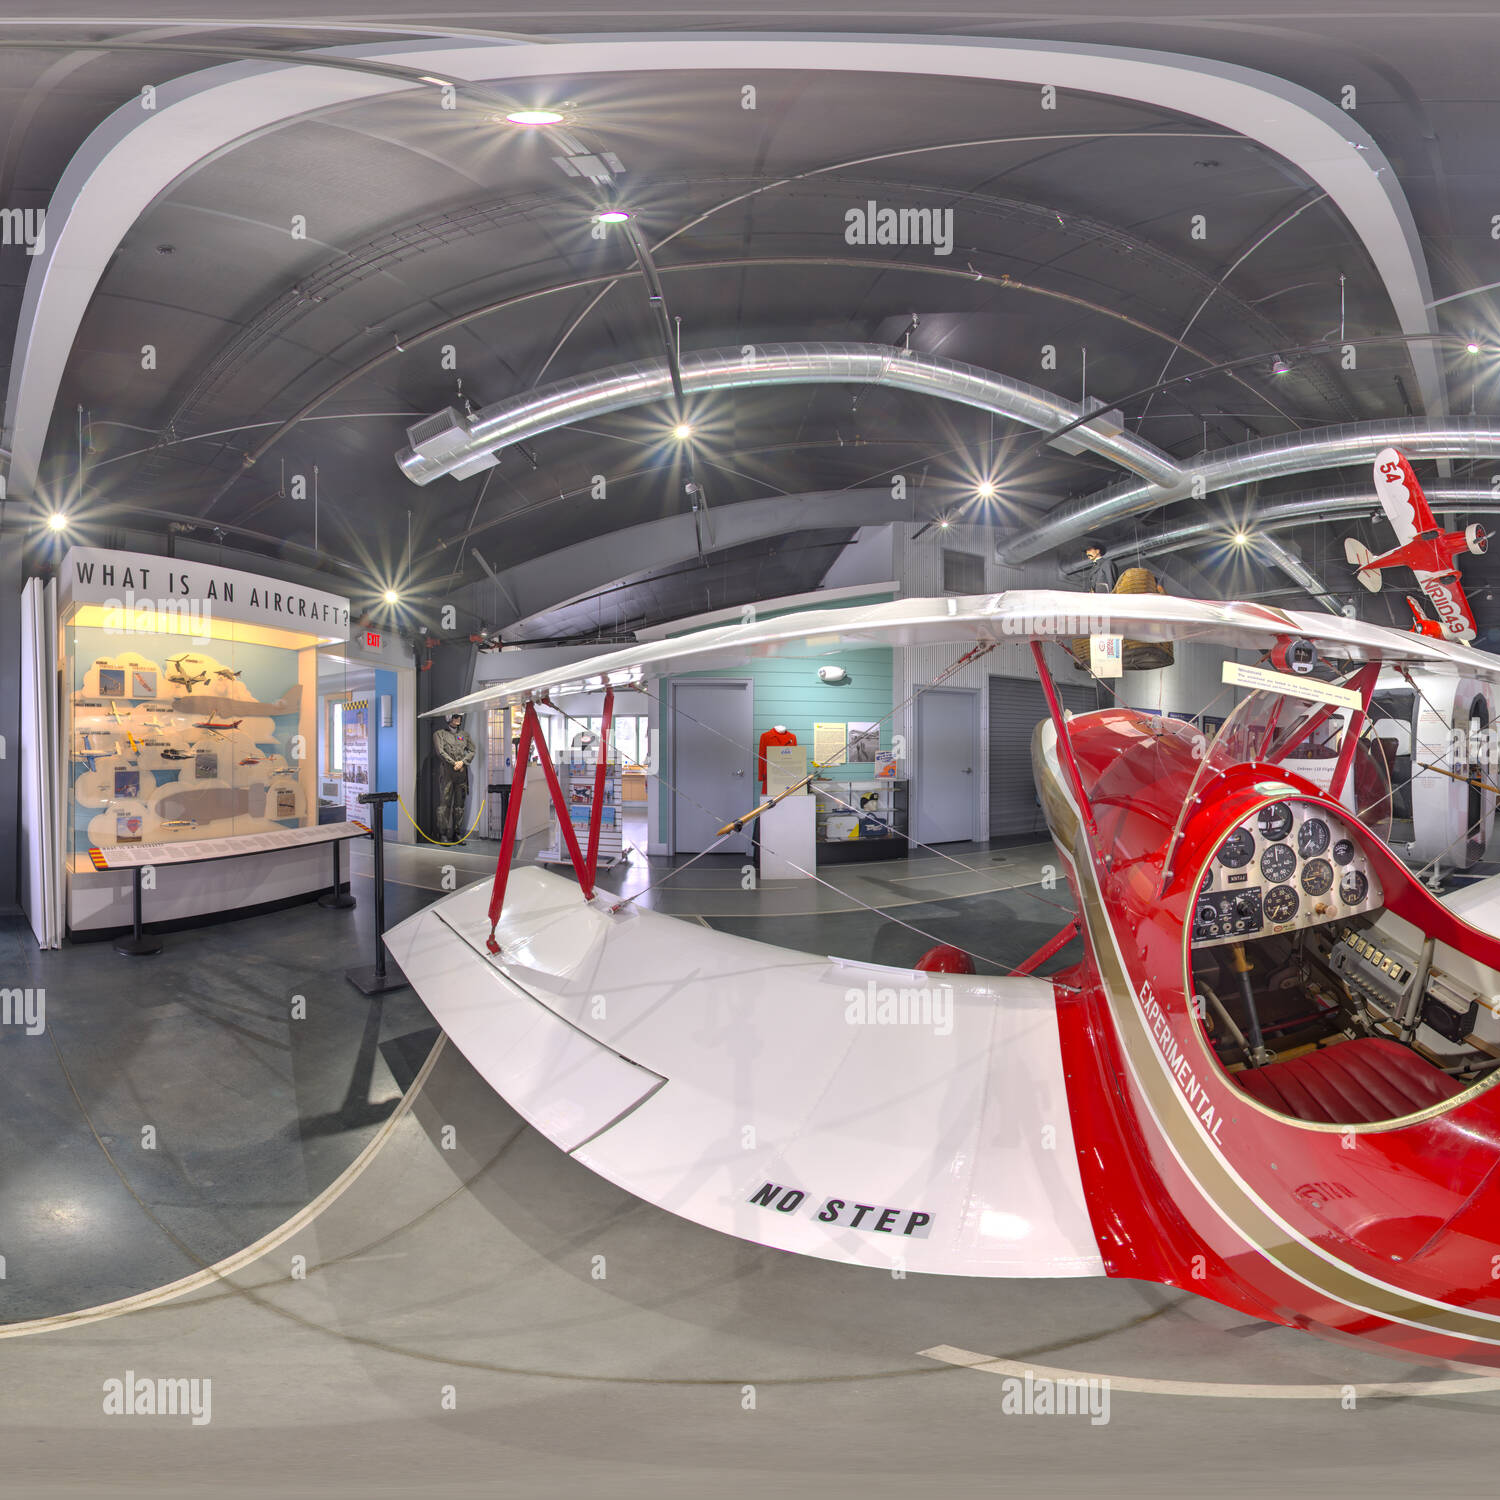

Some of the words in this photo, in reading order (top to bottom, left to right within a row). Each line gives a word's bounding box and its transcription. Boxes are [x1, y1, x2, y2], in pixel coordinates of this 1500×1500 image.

[1380, 461, 1401, 483] 54
[77, 562, 150, 590] WHAT
[169, 572, 189, 595] IS
[207, 579, 234, 603] AN
[250, 587, 349, 627] AIRCRAFT?
[367, 632, 381, 648] EXIT
[1139, 980, 1223, 1145] EXPERIMENTAL
[750, 1183, 805, 1213] NO
[818, 1199, 930, 1236] STEP
